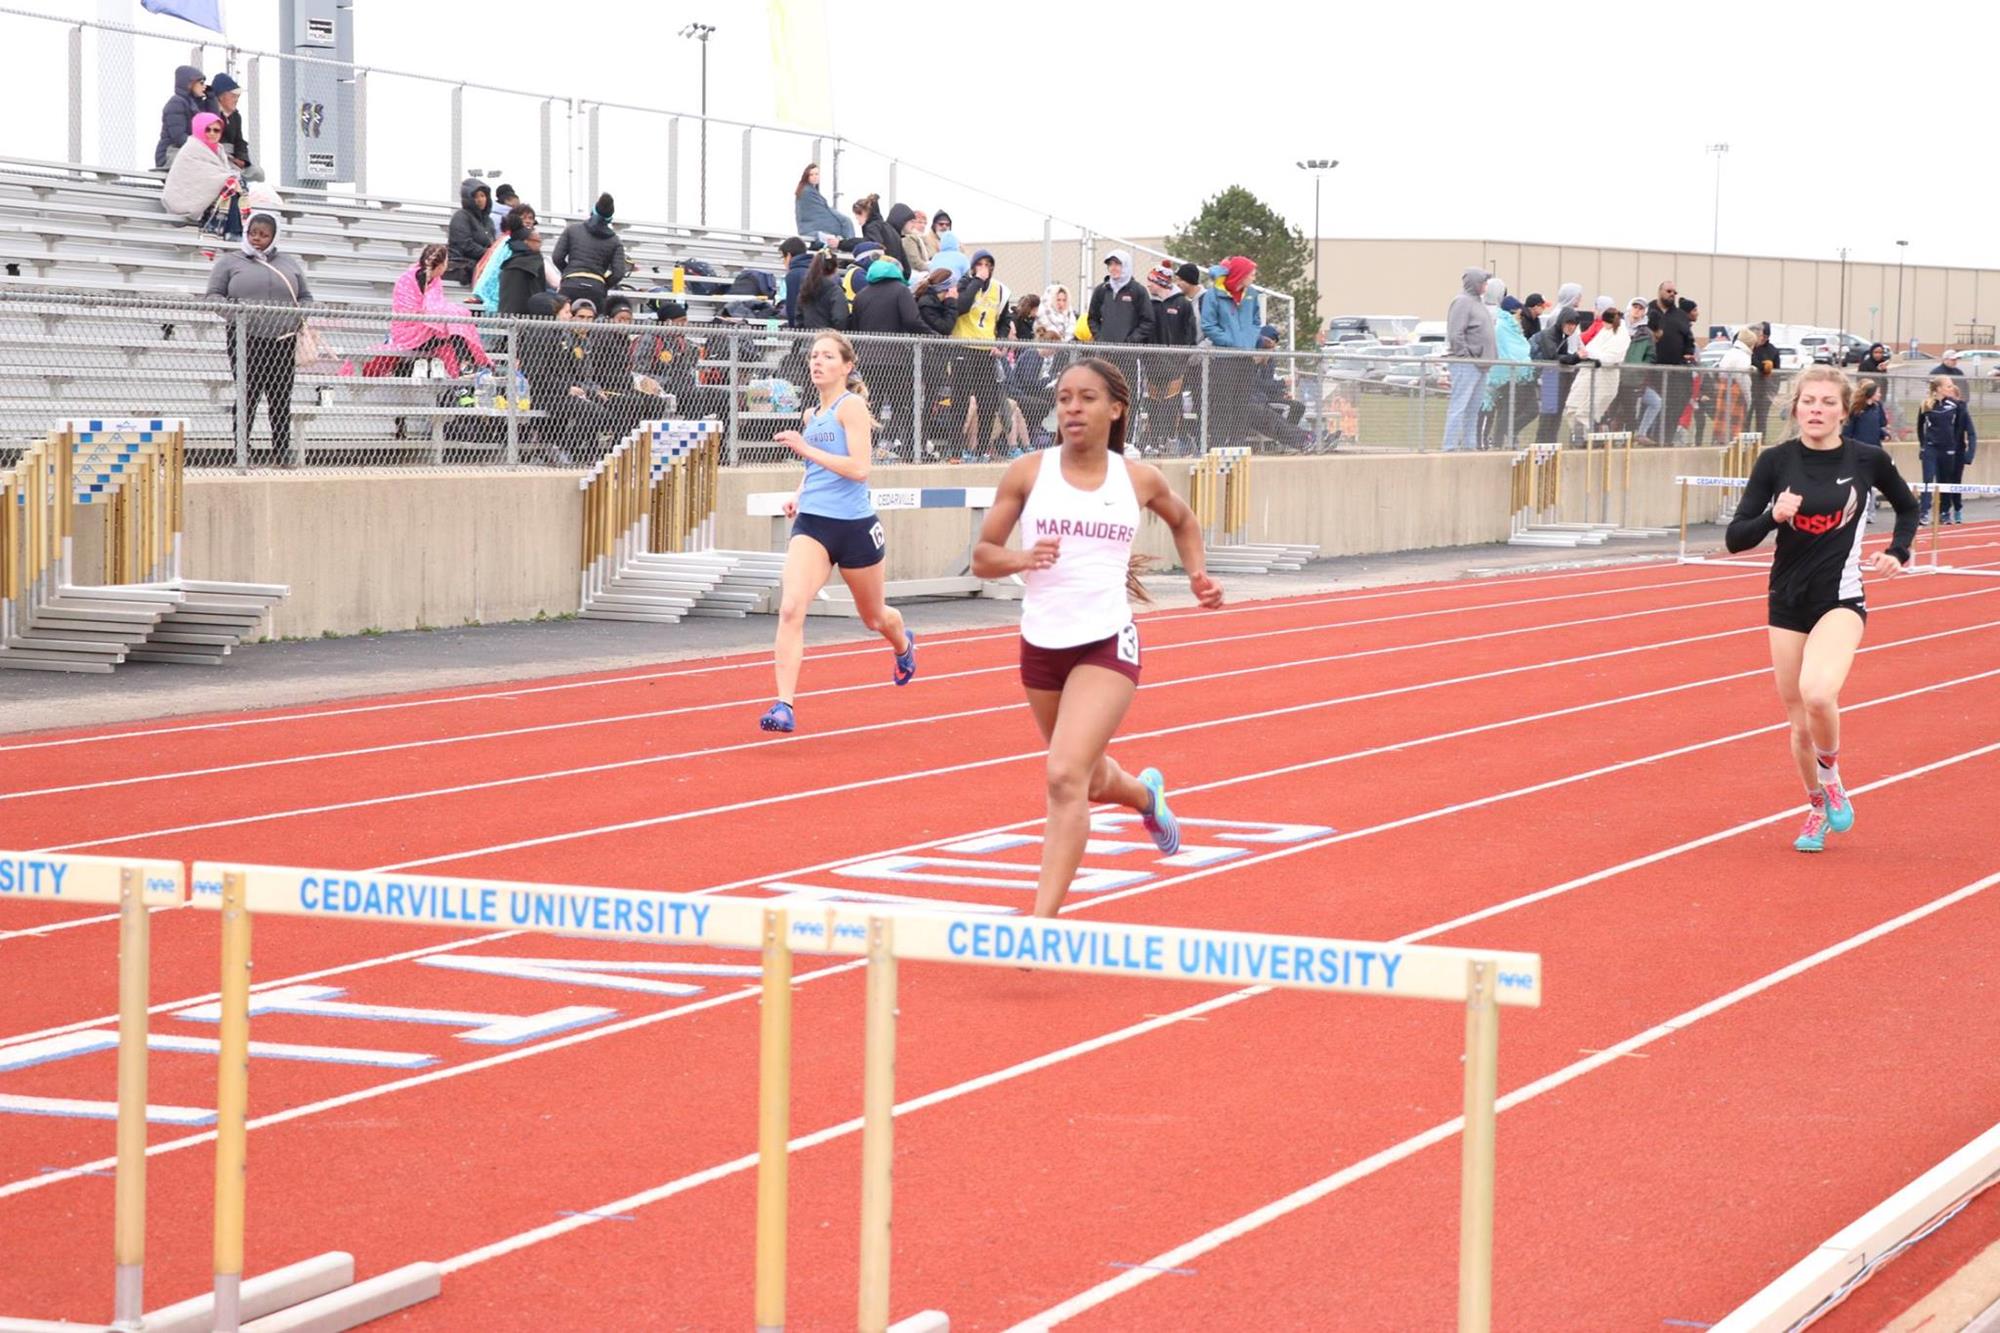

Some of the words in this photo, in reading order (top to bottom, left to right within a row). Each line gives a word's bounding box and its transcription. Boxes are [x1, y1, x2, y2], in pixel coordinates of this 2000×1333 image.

[978, 311, 987, 328] 1
[874, 525, 883, 546] 6
[1036, 518, 1135, 543] MARAUDERS
[1123, 624, 1136, 659] 3
[300, 877, 497, 923] CEDARVILLE
[511, 891, 711, 937] UNIVERSITY
[947, 921, 1164, 971] CEDARVILLE
[1178, 937, 1403, 989] UNIVERSITY
